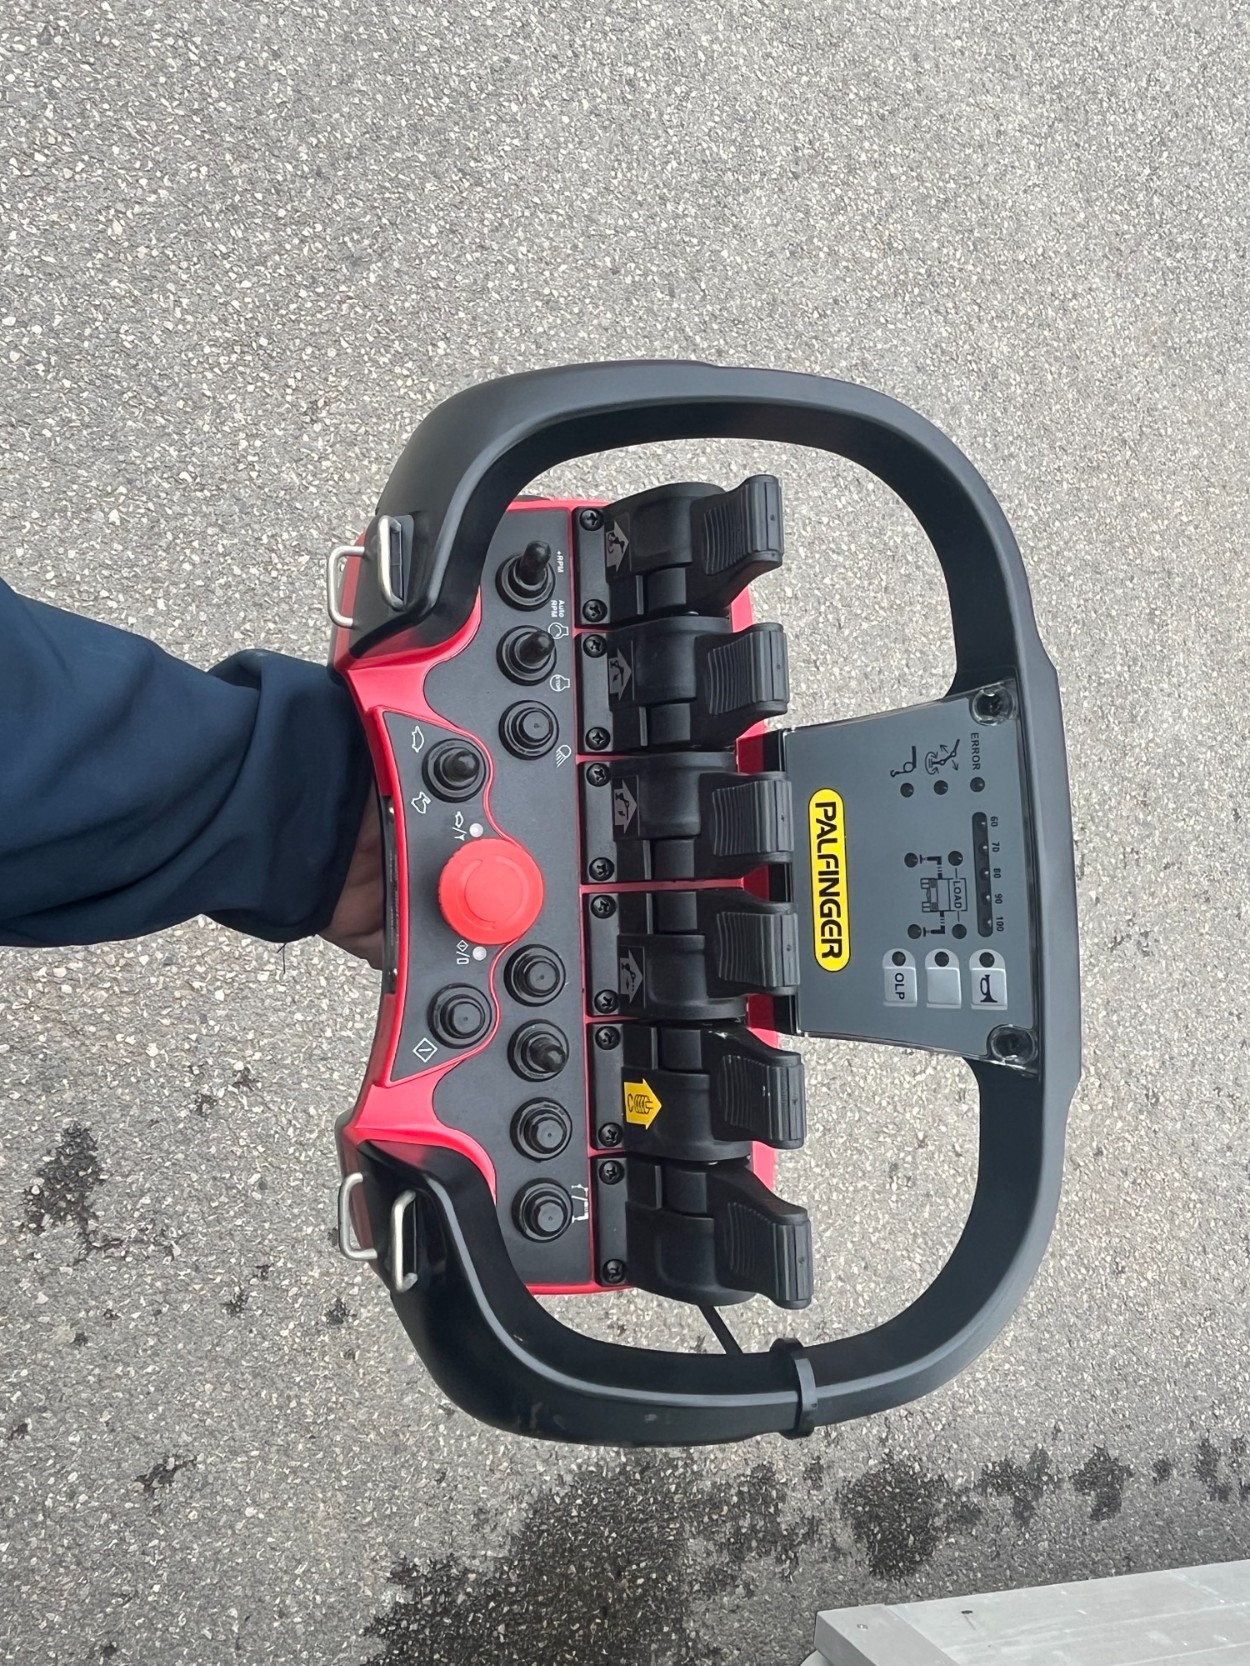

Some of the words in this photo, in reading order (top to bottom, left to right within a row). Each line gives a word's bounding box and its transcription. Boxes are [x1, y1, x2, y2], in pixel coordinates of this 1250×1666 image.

[550, 600, 558, 618] RPM
[970, 732, 981, 771] ERROR
[990, 816, 999, 827] 60
[992, 842, 1000, 852] 70
[814, 801, 843, 959] PALFINGER
[953, 880, 963, 909] LOAD
[995, 894, 1003, 904] 90
[996, 917, 1005, 932] 100
[894, 972, 906, 1000] OLP
